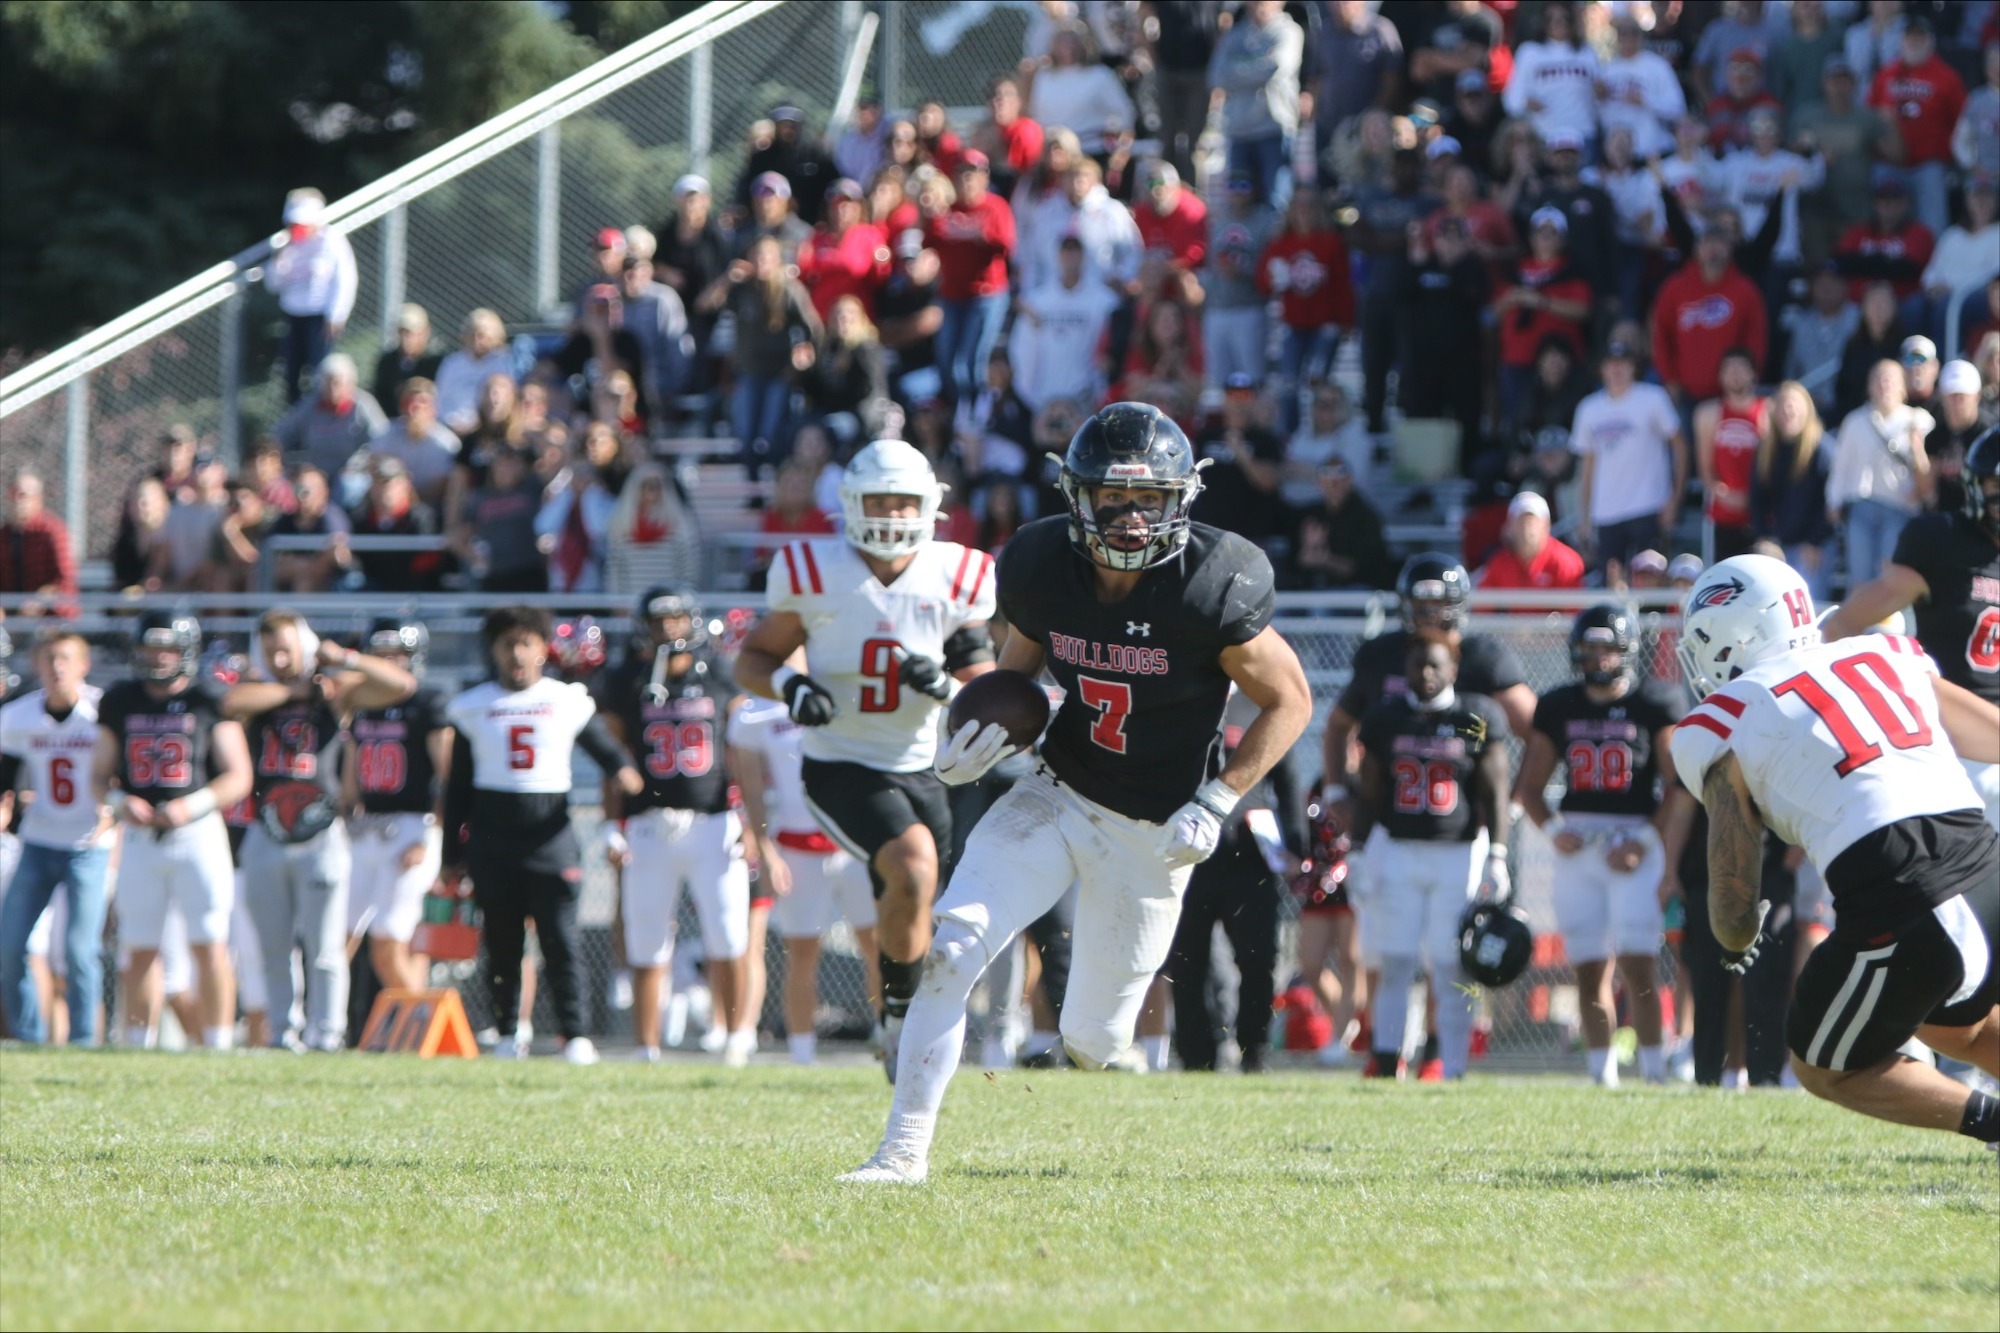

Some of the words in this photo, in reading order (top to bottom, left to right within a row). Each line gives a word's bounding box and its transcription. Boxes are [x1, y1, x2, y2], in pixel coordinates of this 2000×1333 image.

[859, 638, 903, 712] 9
[1049, 631, 1168, 674] BULLDOGS
[1077, 673, 1132, 754] 7
[1770, 652, 1933, 779] 10
[125, 733, 194, 788] 52
[508, 726, 535, 770] 5
[643, 720, 714, 778] 39
[50, 757, 75, 806] 6
